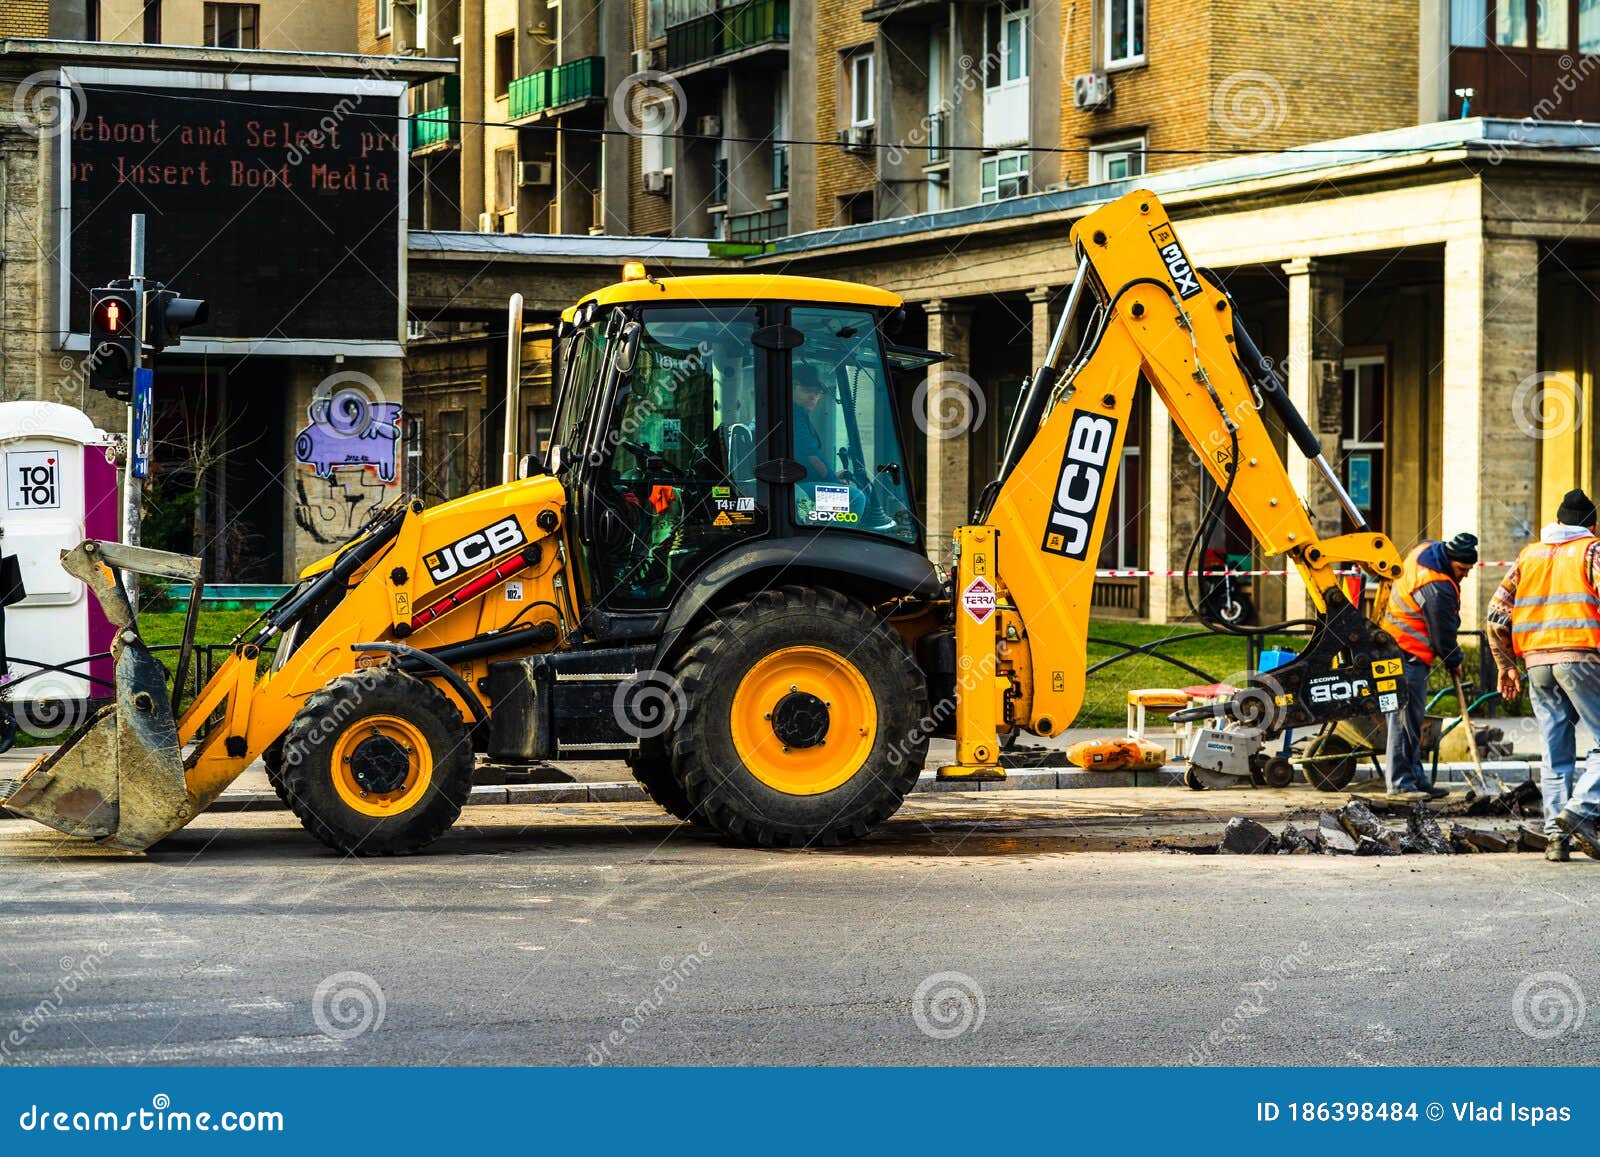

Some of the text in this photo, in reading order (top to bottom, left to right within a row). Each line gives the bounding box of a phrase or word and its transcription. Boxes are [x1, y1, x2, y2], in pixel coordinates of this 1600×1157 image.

[181, 121, 228, 145] and
[247, 120, 341, 150] Select
[116, 156, 211, 185] Insert
[230, 160, 293, 189] Boot
[311, 162, 389, 191] Media
[20, 485, 56, 506] TOI
[1052, 415, 1112, 555] JCB
[431, 519, 524, 581] JCB
[1310, 679, 1369, 703] JCB
